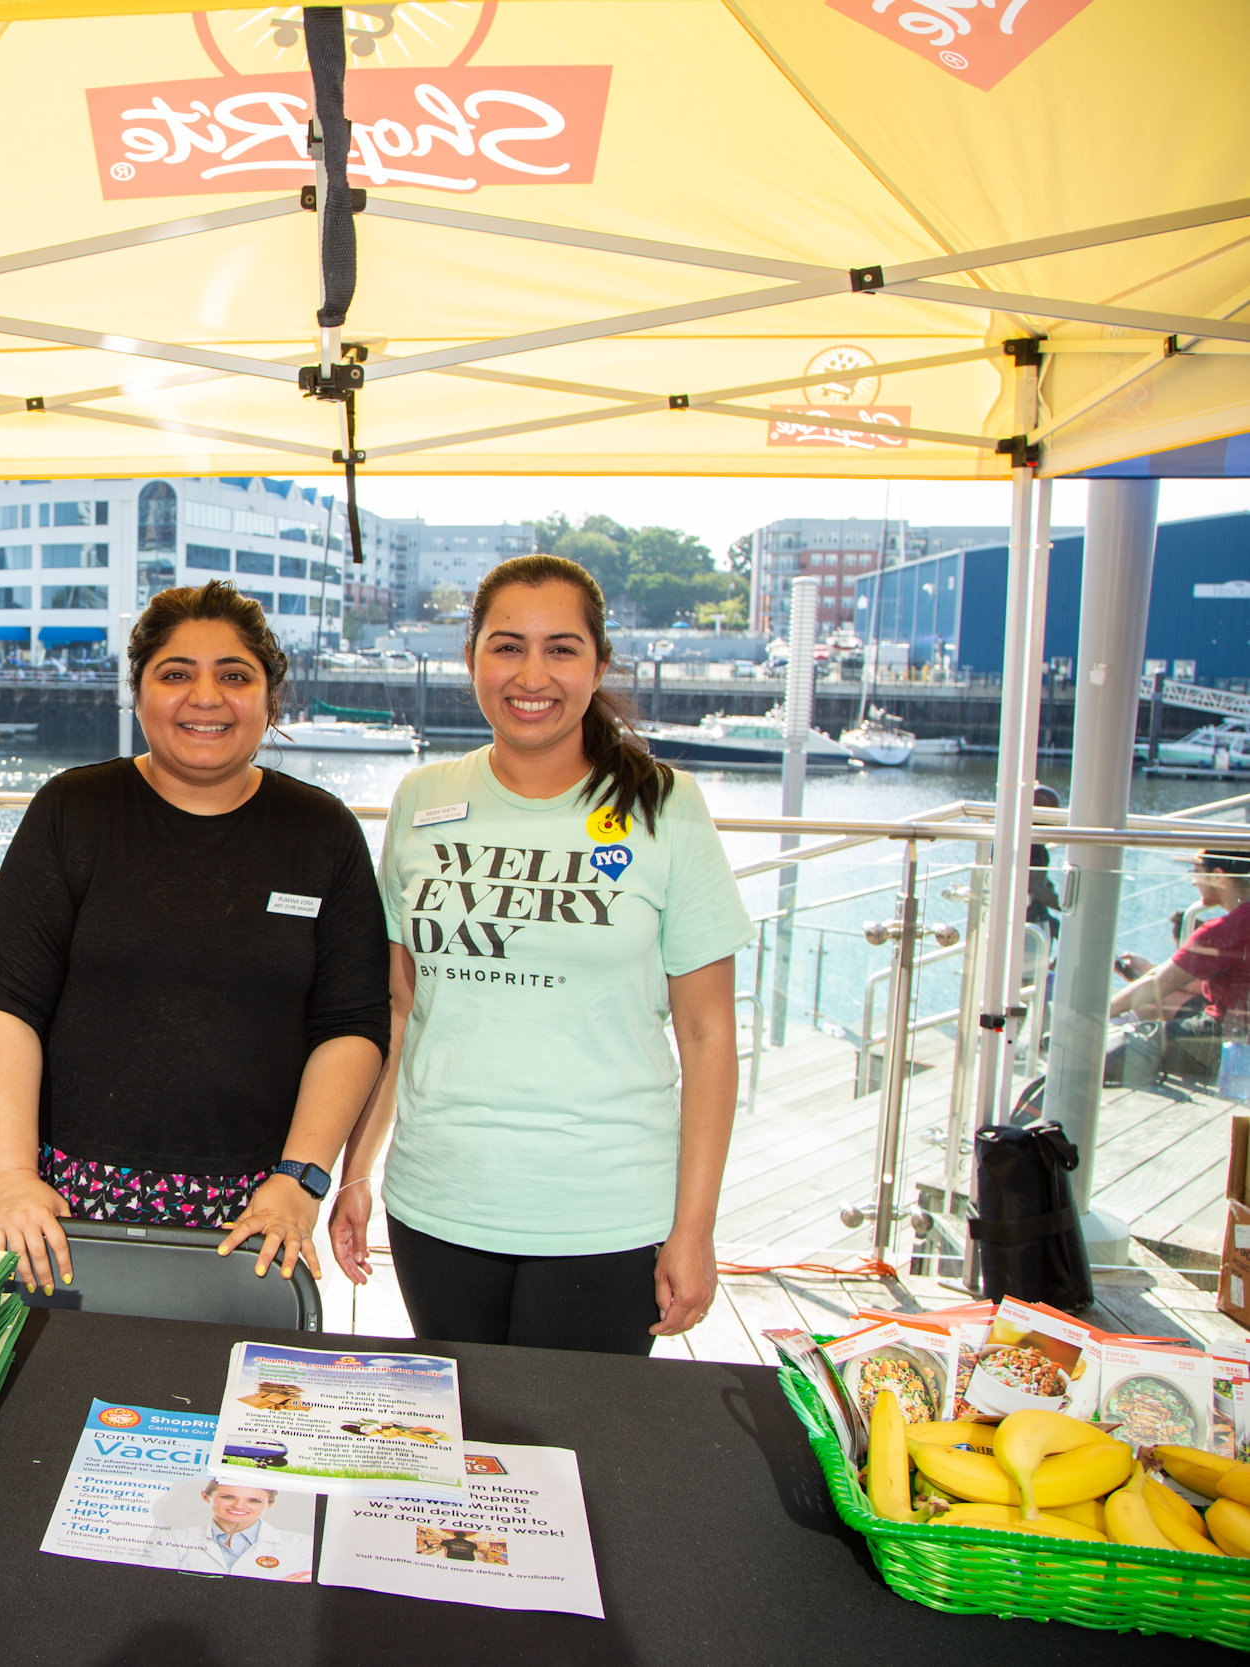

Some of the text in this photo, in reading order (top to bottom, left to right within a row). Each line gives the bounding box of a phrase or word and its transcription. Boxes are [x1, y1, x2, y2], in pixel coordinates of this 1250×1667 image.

[432, 842, 599, 883] WELL
[595, 850, 629, 866] IYQ
[412, 879, 625, 926] EVERY
[410, 918, 525, 959] DAY
[420, 965, 437, 978] BY
[255, 1356, 297, 1366] ShopRite
[309, 1363, 358, 1371] committed
[372, 1367, 413, 1375] reducing
[414, 1370, 443, 1378] waste
[342, 1400, 375, 1408] recycled
[350, 1395, 375, 1404] family
[377, 1397, 416, 1406] ShopRites
[301, 1401, 335, 1409] Million
[338, 1405, 373, 1414] pounds
[391, 1408, 446, 1419] cardboard!
[148, 1425, 178, 1434] Caring
[94, 1431, 190, 1447] Don't Wait...
[281, 1430, 314, 1438] Million
[317, 1433, 353, 1441] pounds
[369, 1438, 407, 1446] organic
[410, 1442, 452, 1452] material
[94, 1439, 210, 1466] Vacci
[83, 1467, 133, 1475] vaccinations
[102, 1463, 137, 1471] certified
[150, 1468, 194, 1477] administer
[104, 1458, 153, 1468] pharmacists
[172, 1465, 202, 1473] trained
[84, 1476, 170, 1492] Pneumonia
[492, 1485, 539, 1496] Home
[81, 1485, 145, 1499] Shingrix
[469, 1492, 530, 1505] hopRite
[77, 1499, 149, 1514] Hepatitis
[112, 1495, 150, 1505] Shingles)
[73, 1508, 110, 1519] HPV
[368, 1500, 548, 1527] We will deliver right to
[469, 1502, 508, 1513] Main
[513, 1506, 532, 1515] St.
[69, 1522, 110, 1535] Tdap
[71, 1515, 171, 1531] (Human Papillomavirus)
[353, 1509, 565, 1538] your door 7 days a week!
[66, 1530, 104, 1540] (Tetanus,
[107, 1535, 153, 1545] Diphtheria
[165, 1542, 208, 1551] Pertussis)
[375, 1554, 435, 1568] ShopRite.com
[476, 1568, 506, 1577] details
[516, 1573, 565, 1582] availability
